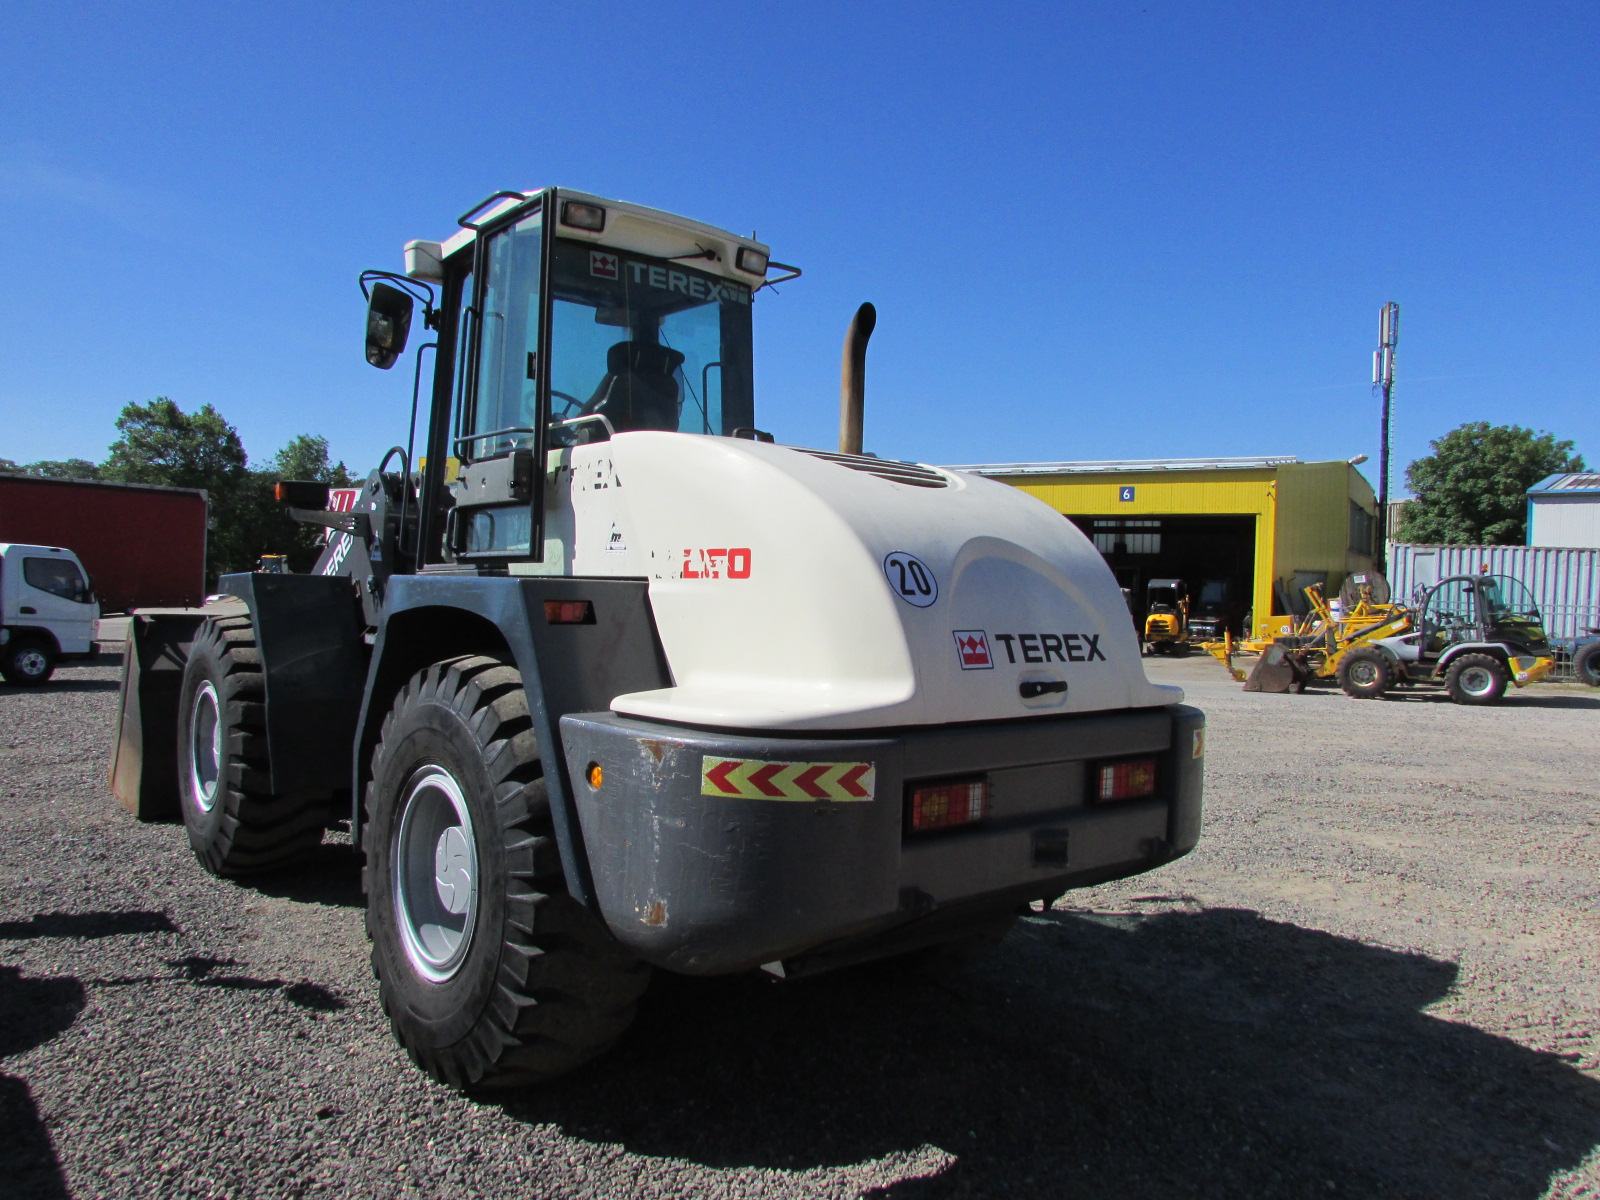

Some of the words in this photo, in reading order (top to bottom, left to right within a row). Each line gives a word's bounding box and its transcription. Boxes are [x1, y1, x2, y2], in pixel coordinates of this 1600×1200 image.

[627, 260, 724, 304] TEREX
[1123, 488, 1130, 500] 6
[890, 559, 932, 596] 20
[994, 633, 1107, 664] TEREX
